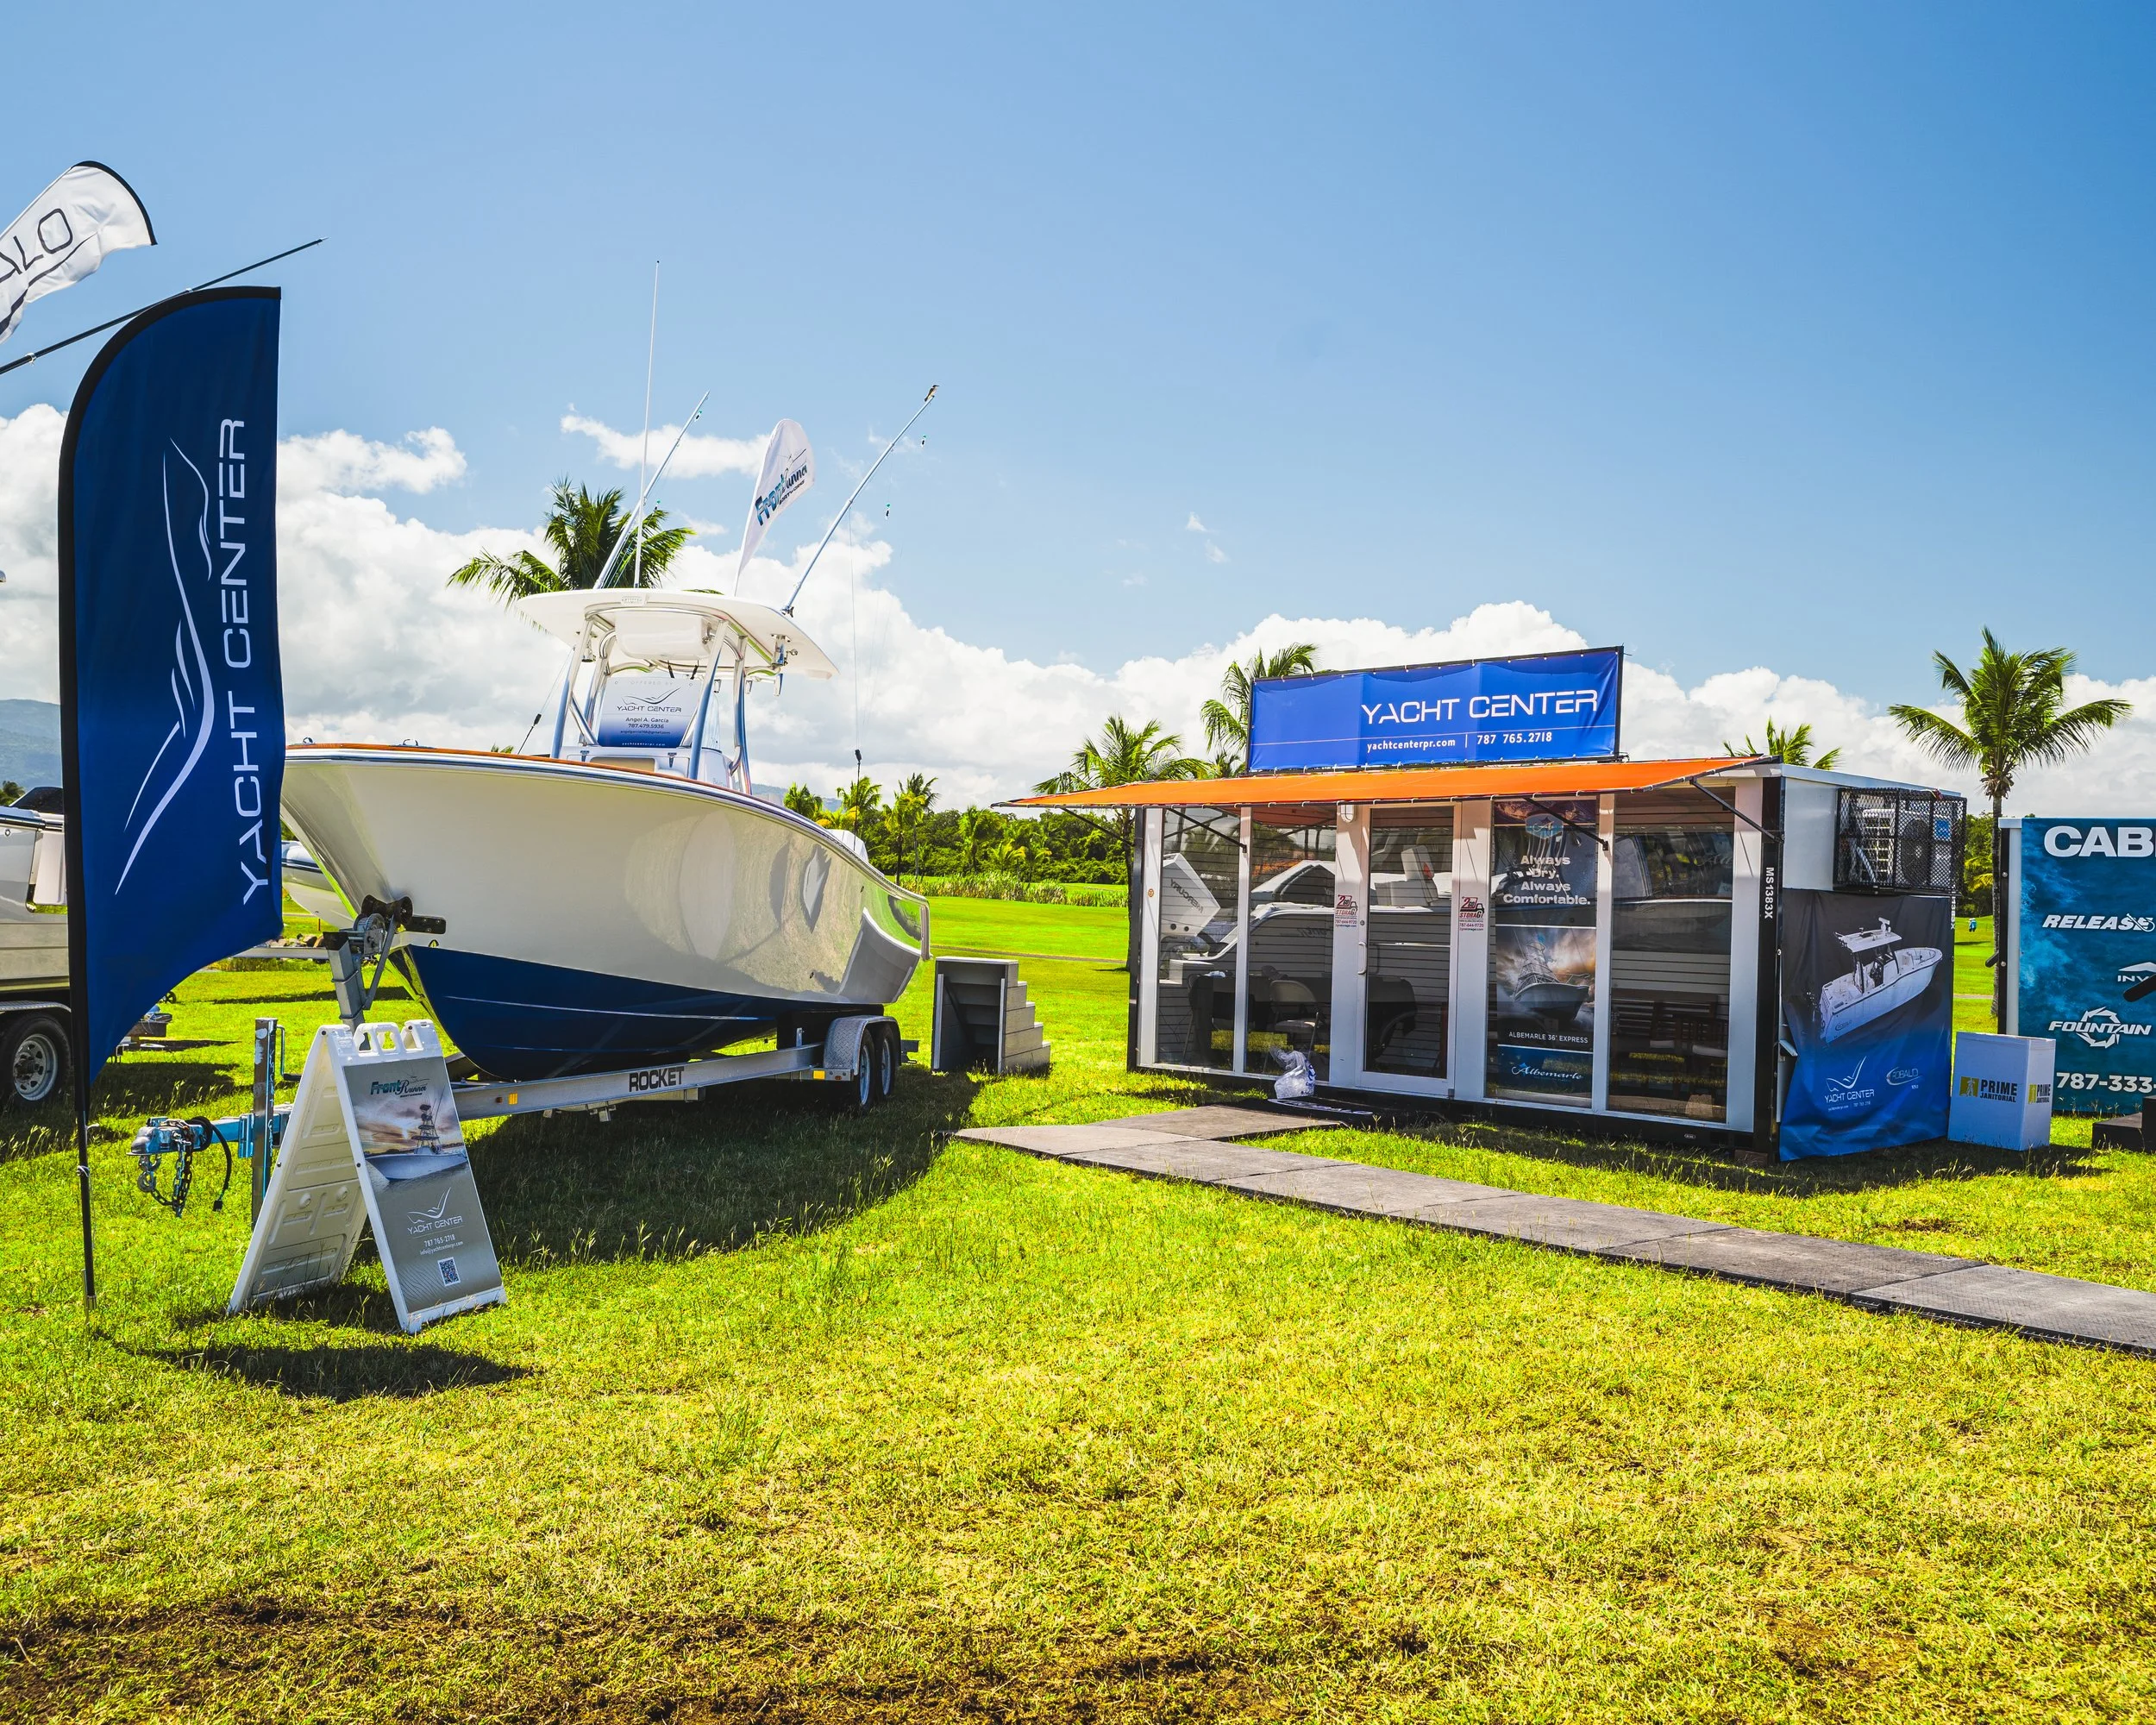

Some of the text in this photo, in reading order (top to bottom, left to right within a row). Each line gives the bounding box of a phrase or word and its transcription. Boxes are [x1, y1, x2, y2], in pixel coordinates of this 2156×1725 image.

[218, 418, 268, 906] YACHT CENTER
[1361, 689, 1598, 724] YACHT CENTER
[1367, 732, 1552, 753] yachtcenterpr.com 787 765.2718
[2044, 825, 2156, 857] CAB
[1520, 855, 1571, 866] Always
[1532, 868, 1559, 879] Dry.
[1520, 881, 1571, 893] Always
[1764, 867, 1775, 919] MS1383X
[1503, 894, 1591, 905] Comfortable.
[2042, 914, 2155, 932] RELEASE
[2048, 1021, 2153, 1036] FOUNTAIN
[1508, 1032, 1546, 1040] ALBEMARLE
[1558, 1035, 1589, 1044] EXPRESS
[629, 1066, 685, 1093] ROCKET
[1511, 1066, 1584, 1080] Albemarle
[1980, 1079, 2018, 1096] PRIME
[2036, 1083, 2051, 1097] PRIME
[2056, 1072, 2156, 1094] 787-333
[1824, 1088, 1875, 1104] YACHT CENTER
[1979, 1093, 2016, 1103] JANITORIAL
[407, 1215, 463, 1235] YACHT CENTER
[423, 1239, 434, 1247] 787
